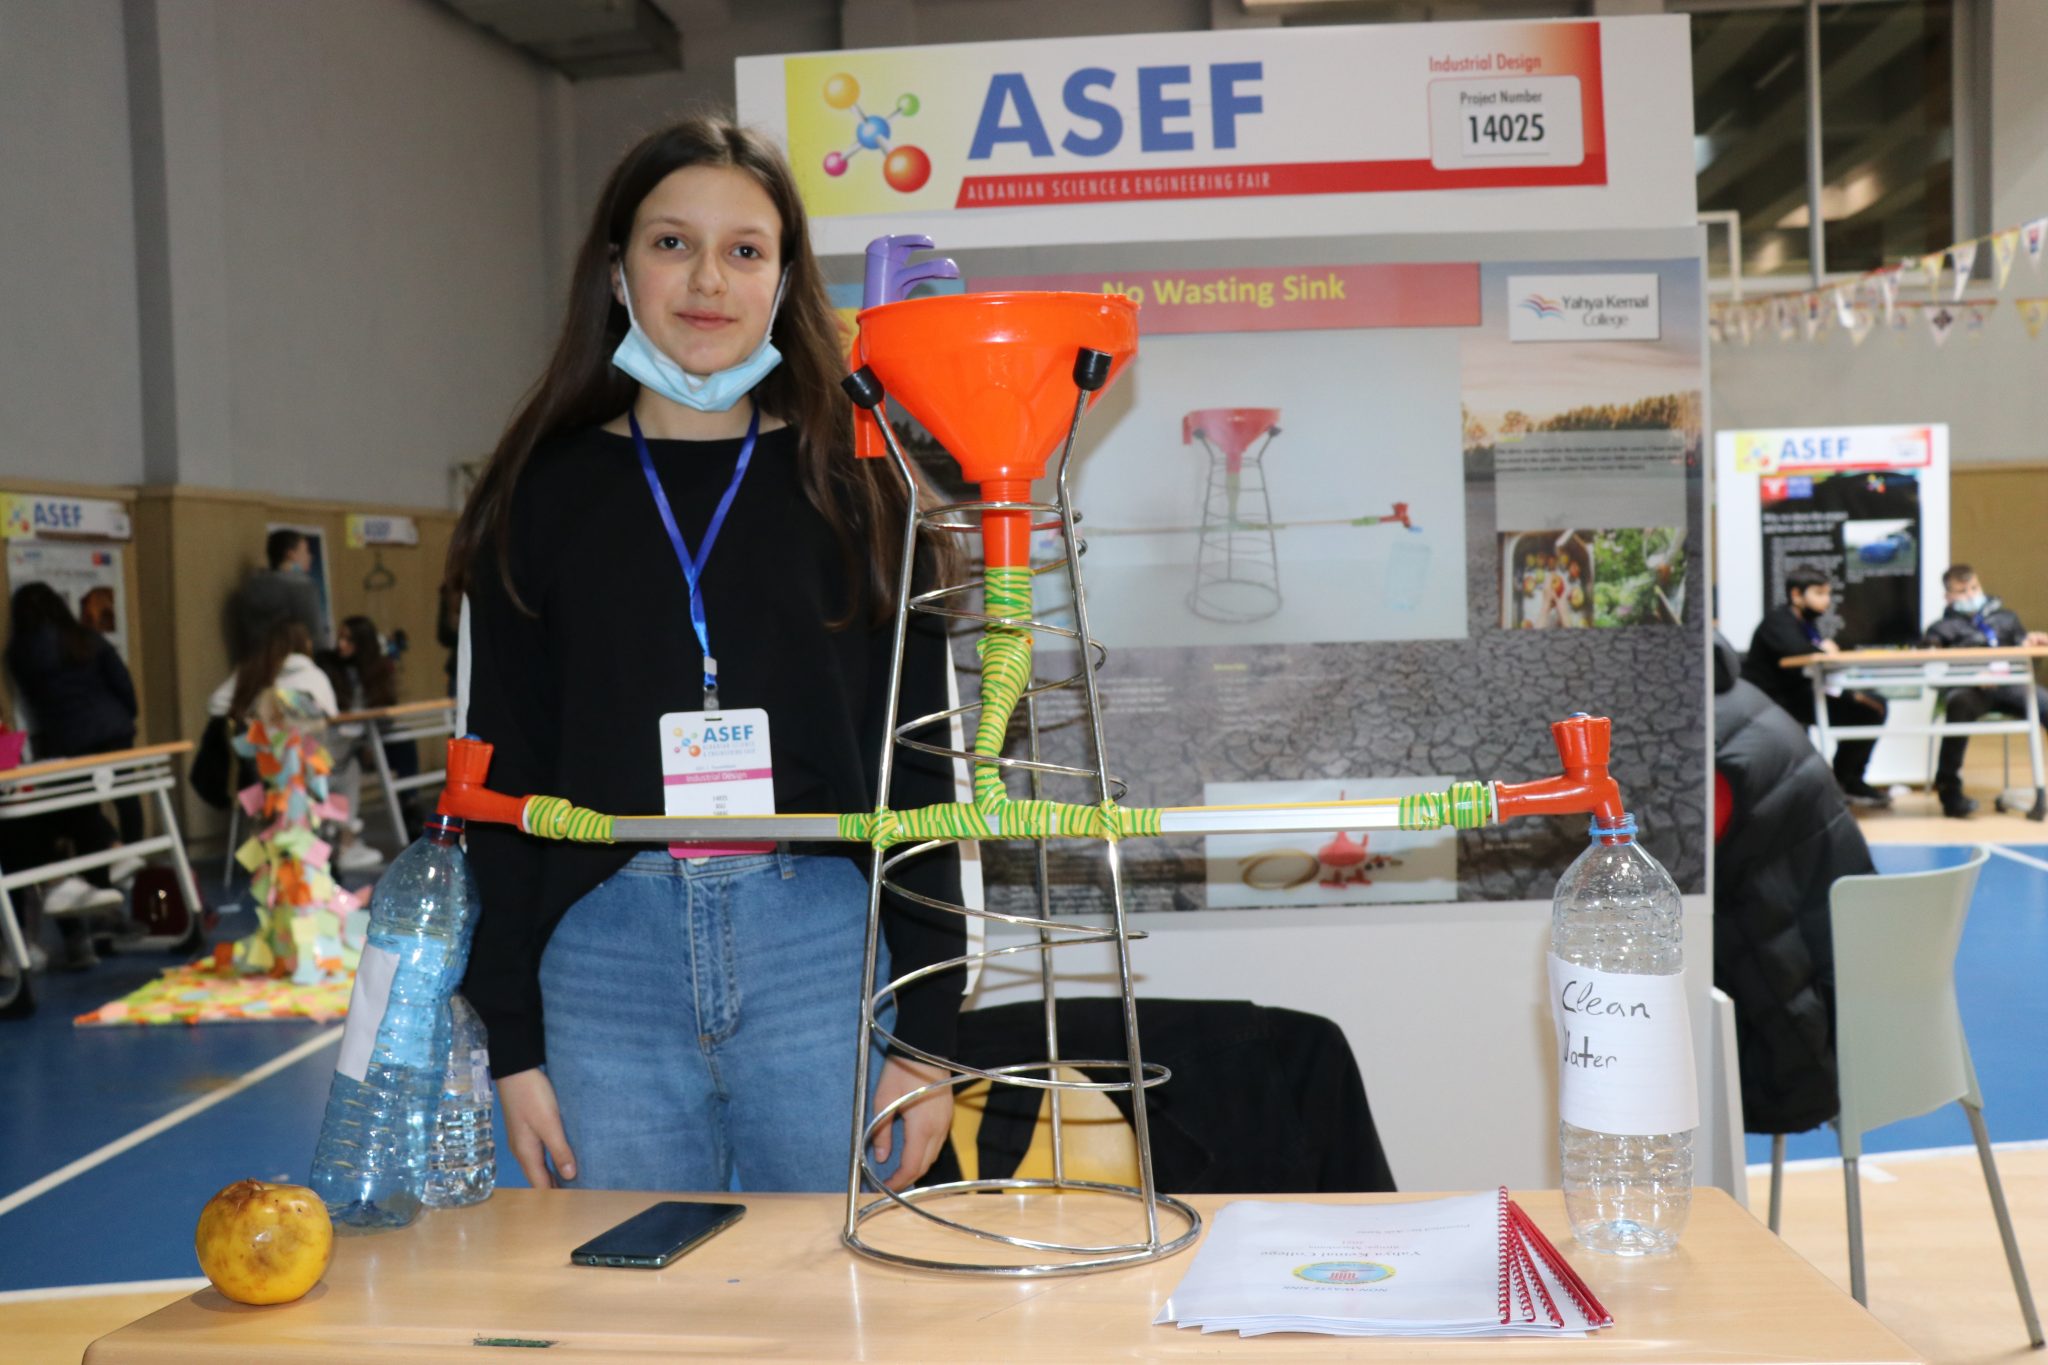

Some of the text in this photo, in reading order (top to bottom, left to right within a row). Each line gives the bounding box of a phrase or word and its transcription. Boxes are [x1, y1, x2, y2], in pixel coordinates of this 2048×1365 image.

[1429, 53, 1542, 73] Industrial Design
[1460, 89, 1542, 107] Project Number
[966, 61, 1264, 160] ASEF
[1468, 113, 1546, 144] 14025
[967, 171, 1271, 200] ALBANIAN SCIENCE & ENGINEERING FAIR
[1153, 277, 1275, 308] Wasting
[1283, 273, 1346, 301] Sink
[1562, 294, 1649, 311] Yahya Kemal
[1583, 312, 1629, 329] College
[1780, 436, 1851, 460] ASEF
[33, 502, 82, 527] ASEF
[703, 725, 754, 743] ASEF
[1562, 981, 1651, 1018] Clean
